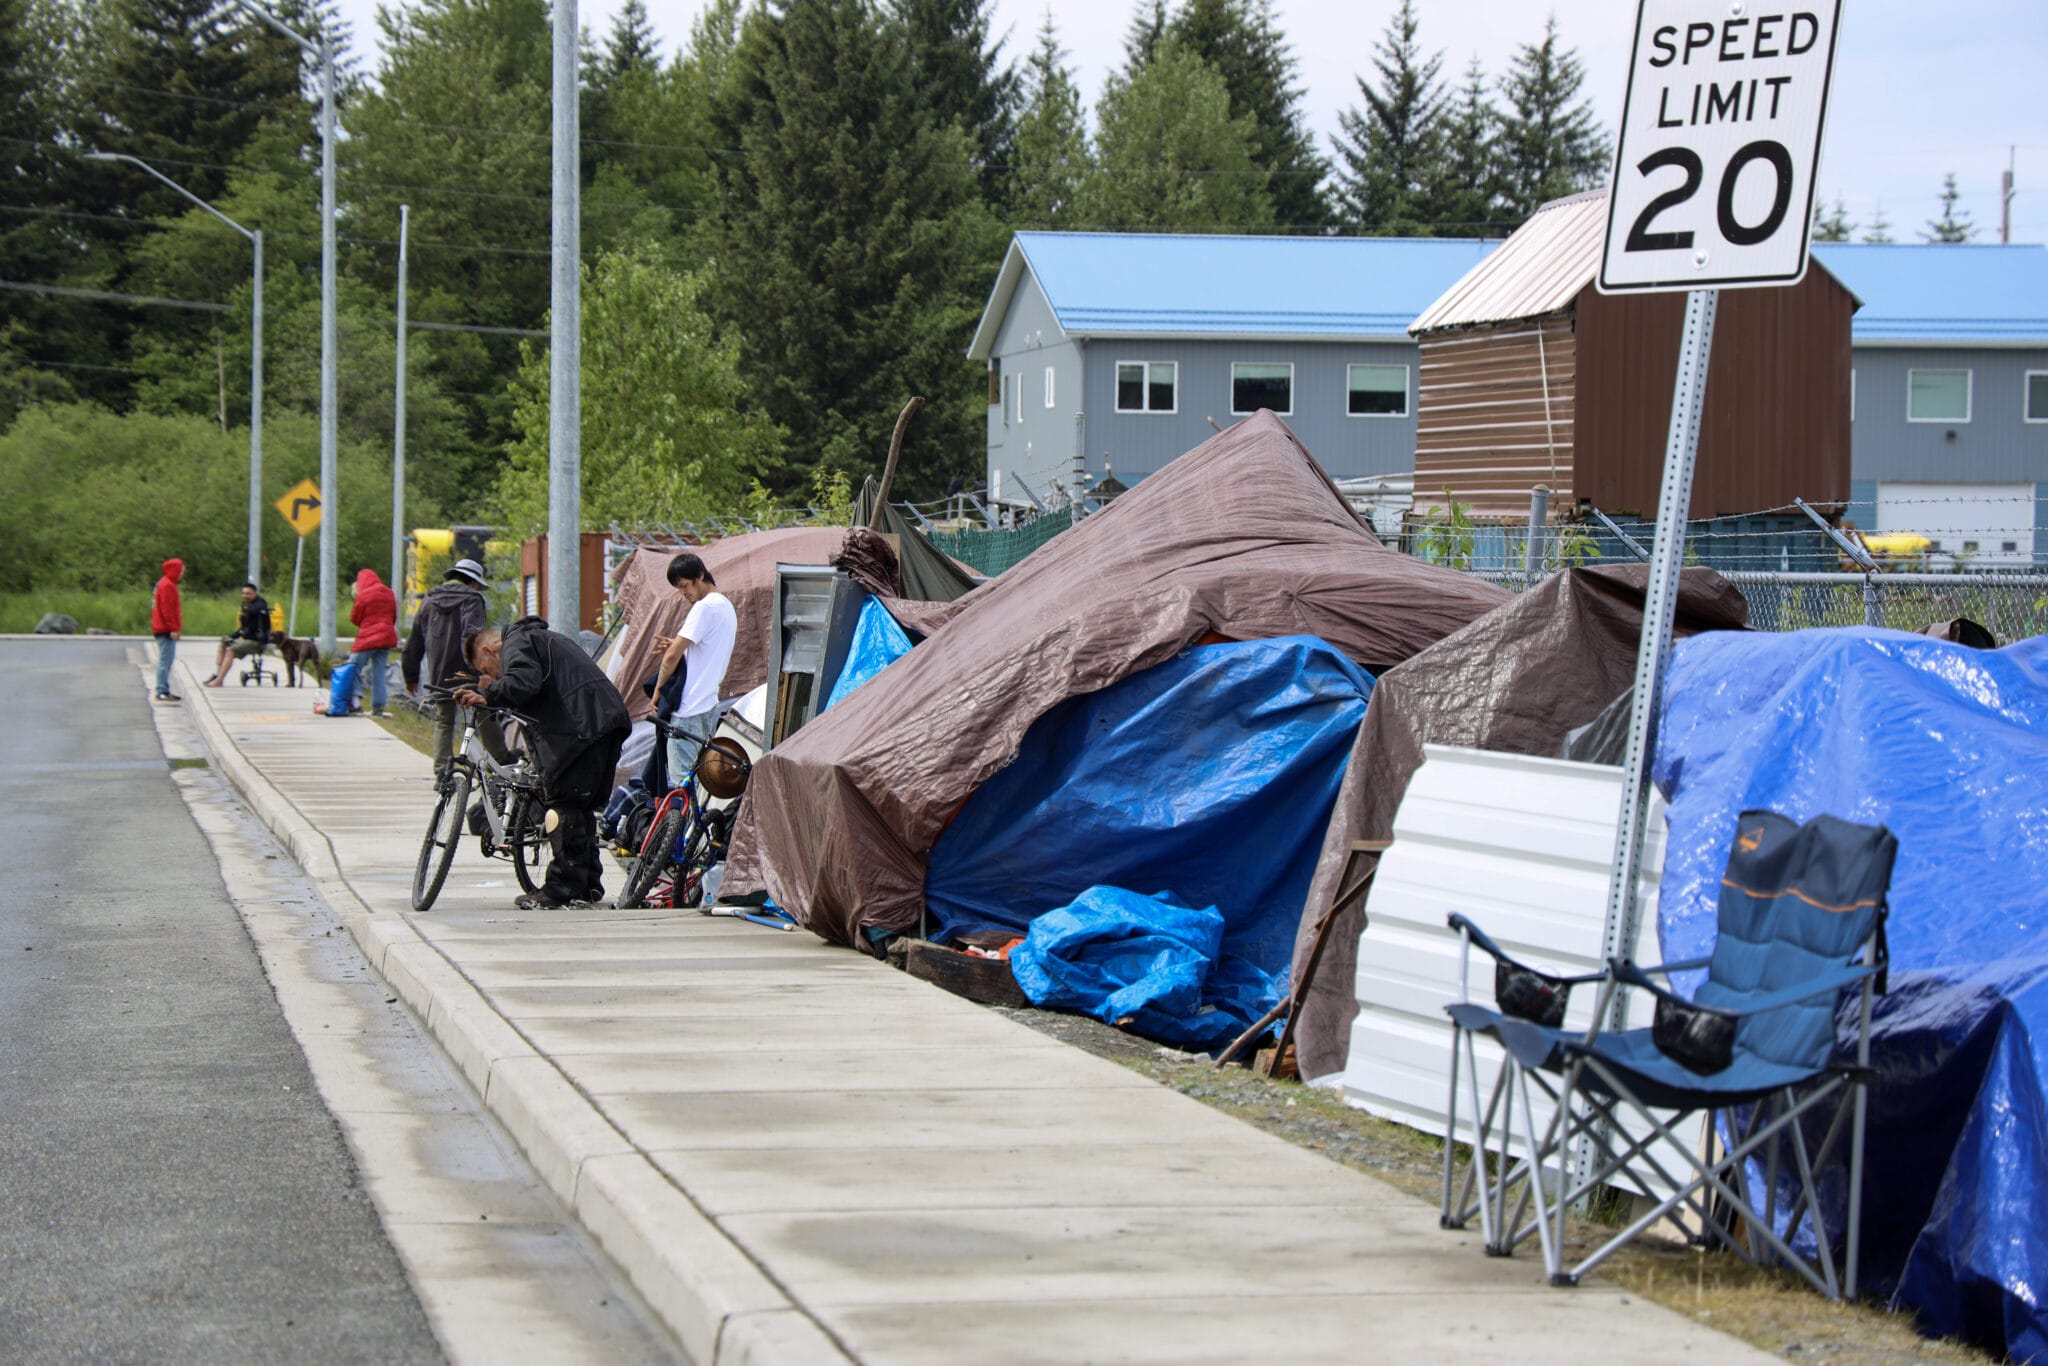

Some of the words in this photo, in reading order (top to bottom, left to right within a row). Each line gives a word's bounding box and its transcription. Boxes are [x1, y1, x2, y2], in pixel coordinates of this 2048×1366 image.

[1649, 12, 1819, 68] SPEED
[1657, 76, 1792, 128] LIMIT
[1624, 140, 1793, 252] 20
